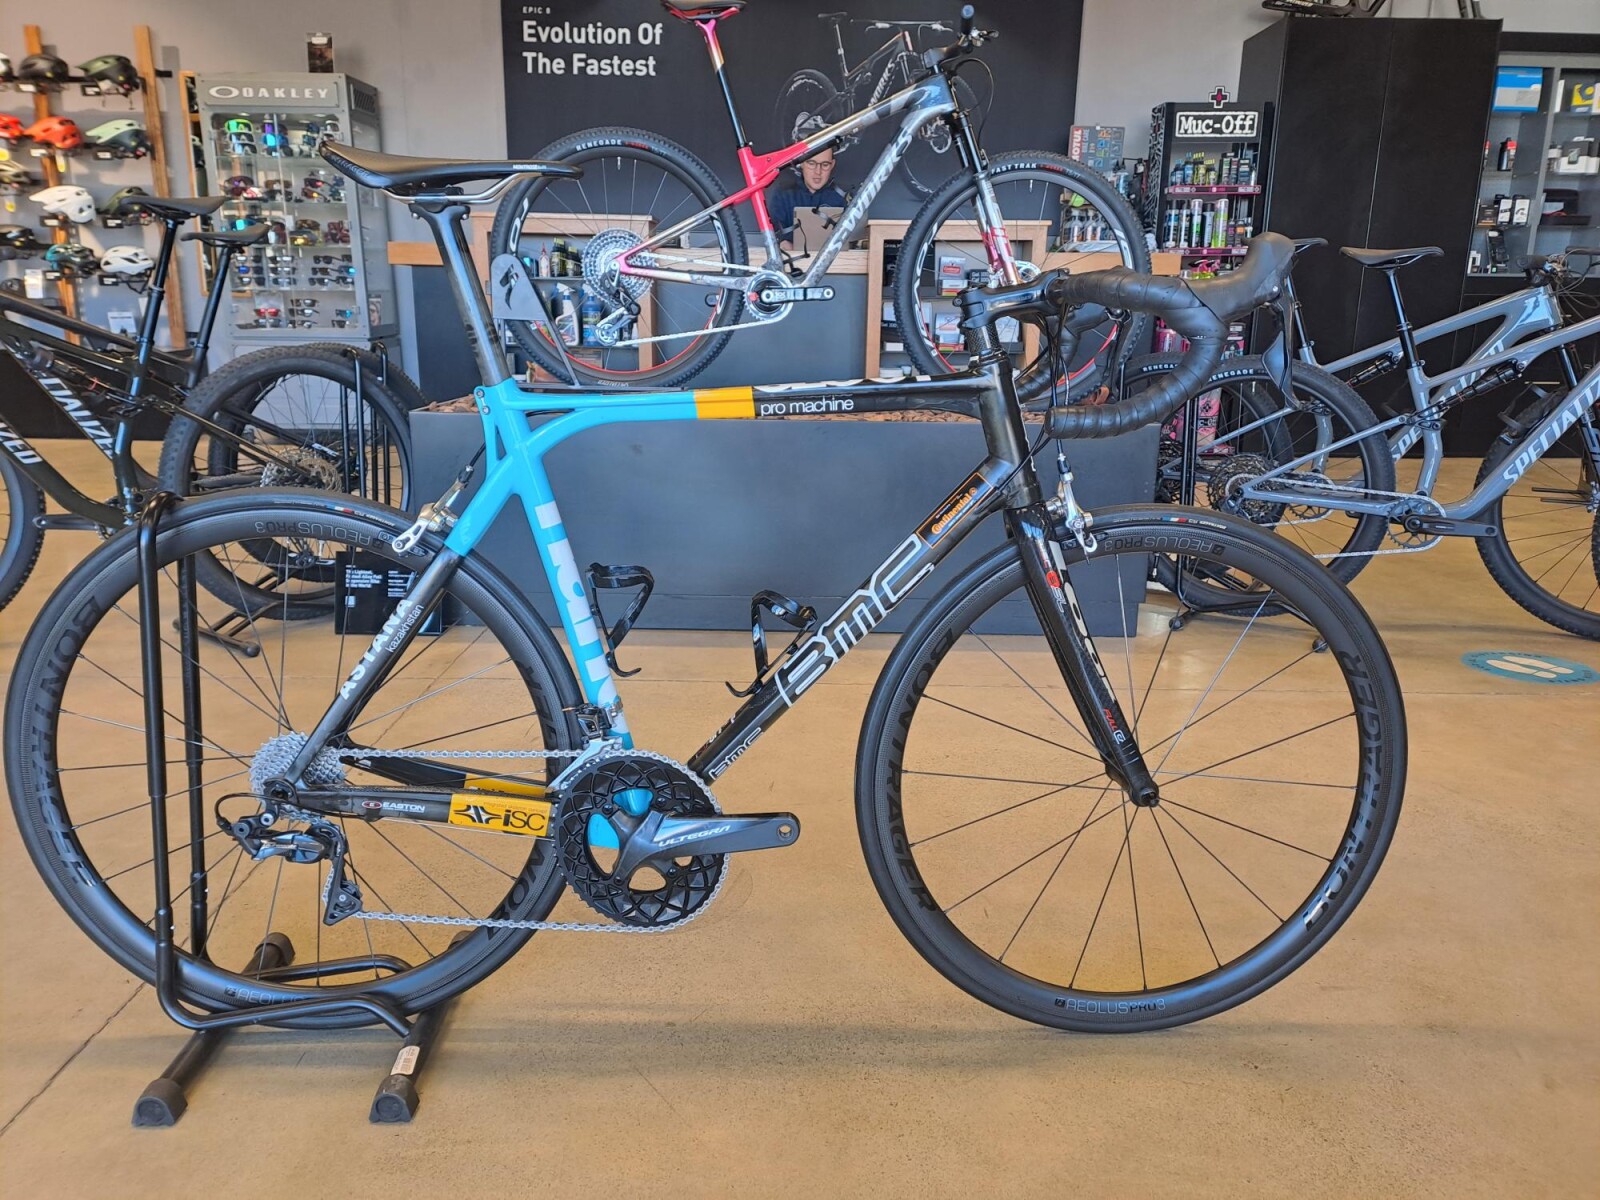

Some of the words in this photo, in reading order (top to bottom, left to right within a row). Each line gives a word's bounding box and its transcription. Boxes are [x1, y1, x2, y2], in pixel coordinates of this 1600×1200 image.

[522, 5, 543, 14] EPIC
[521, 20, 632, 45] Evolution
[637, 22, 663, 46] Of
[522, 51, 566, 75] The
[572, 54, 657, 77] Fastest
[242, 87, 329, 100] OAKLEY
[1179, 114, 1256, 135] Muc-Off
[575, 139, 622, 152] RENEGADE
[991, 164, 1012, 174] FAST
[760, 401, 787, 417] pro
[789, 395, 854, 414] machine
[384, 603, 425, 653] kazakhstan
[340, 598, 414, 700] ASTANA
[1103, 707, 1118, 731] FULL
[885, 626, 954, 913] BONTRAGER
[382, 801, 426, 811] EASTON
[502, 809, 546, 831] iSC
[658, 823, 732, 848] ULTEGRA
